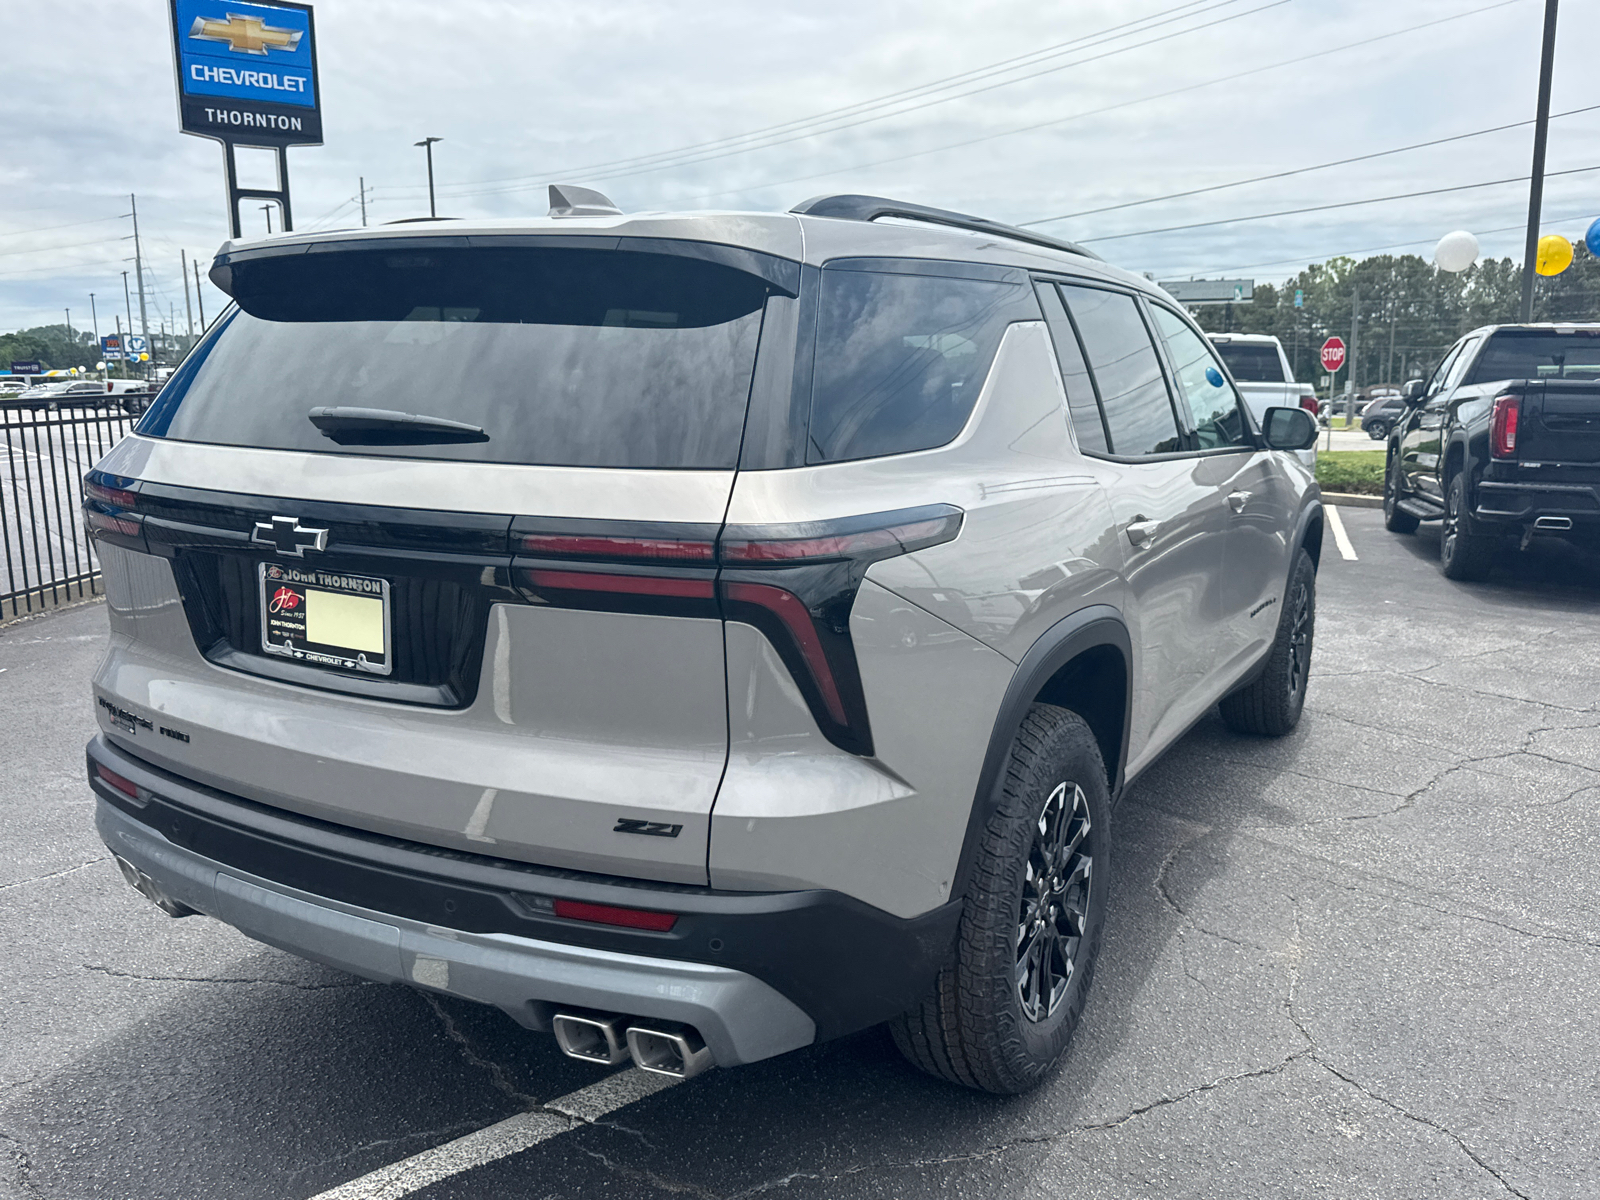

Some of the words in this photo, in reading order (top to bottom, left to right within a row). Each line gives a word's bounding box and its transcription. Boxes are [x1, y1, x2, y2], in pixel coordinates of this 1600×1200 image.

[190, 64, 307, 92] CHEVROLET
[205, 108, 302, 131] THORNTON
[1322, 347, 1344, 361] STOP
[288, 569, 316, 583] JOHN
[318, 574, 381, 593] THORNTON
[306, 653, 342, 665] CHEVROLET
